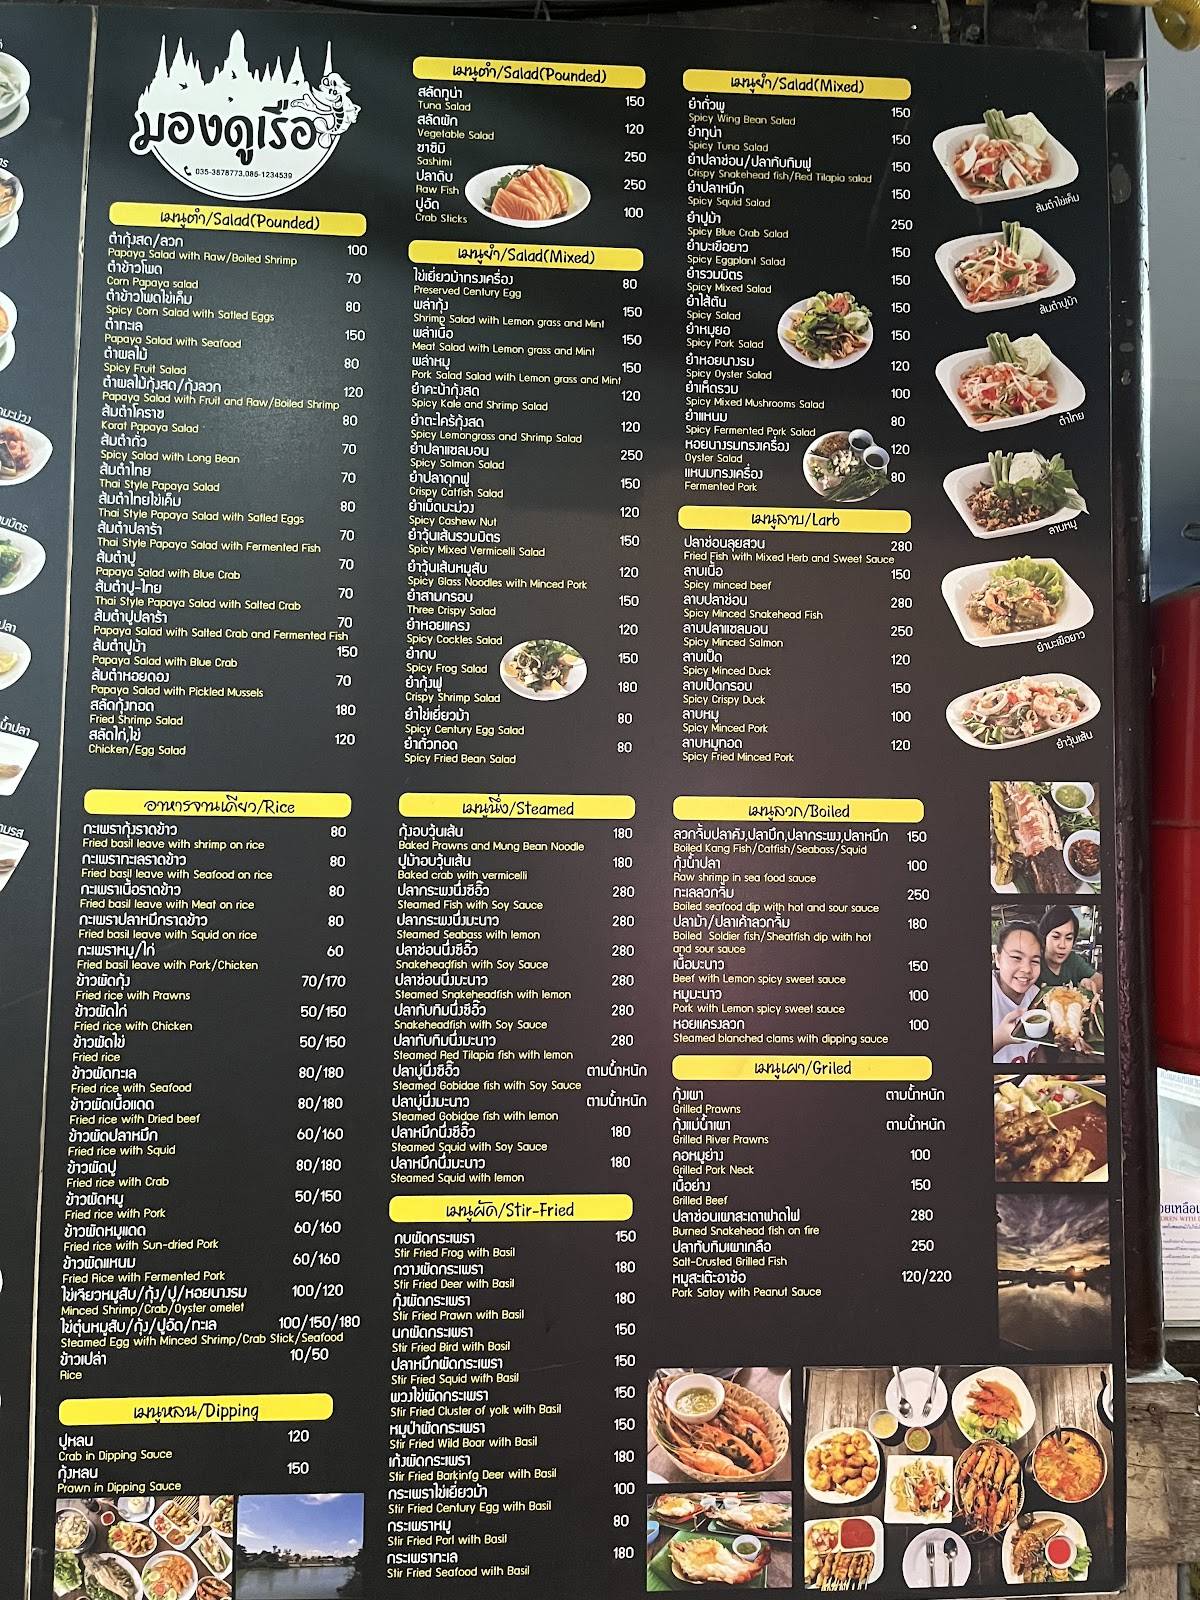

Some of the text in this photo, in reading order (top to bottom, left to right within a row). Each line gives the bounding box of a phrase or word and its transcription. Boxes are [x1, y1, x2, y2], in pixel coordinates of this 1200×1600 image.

[626, 96, 644, 107] 150
[892, 107, 910, 118] 150
[134, 100, 317, 165] มองดูเรือ
[416, 185, 459, 194] Raw Fish
[624, 179, 646, 190] 250
[891, 219, 913, 230] 250
[348, 245, 367, 255] 100
[108, 248, 297, 267] Papaya Salad with Raw/Boiled Shrimp
[623, 279, 637, 289] 80
[414, 285, 521, 299] Preserved Century Egg
[345, 330, 365, 341] 150
[891, 389, 910, 399] 100
[686, 397, 824, 409] Spicy Mixed Mushrooms Salad
[620, 507, 639, 517] 120
[891, 541, 912, 551] 280
[684, 580, 771, 591] Spicy minced beef
[337, 646, 358, 657] 150
[891, 654, 910, 665] 120
[406, 663, 487, 675] Spicy Frog Salad
[91, 685, 263, 697] Papaya Salad with Pickled Mussels
[618, 681, 637, 692] 180
[336, 704, 356, 715] 180
[335, 734, 355, 745] 120
[89, 744, 186, 756] Chicken/Egg Salad
[683, 752, 794, 762] Spicy Fried Minced Pork
[331, 826, 346, 837] 80
[613, 828, 632, 838] 180
[83, 838, 107, 847] Fried
[111, 839, 133, 848] basil
[137, 839, 164, 848] leave
[168, 839, 190, 848] with
[194, 840, 226, 851] shrimp
[399, 841, 584, 852] Baked Prawns and Mung Bean Noodle
[908, 889, 929, 900] 250
[302, 974, 346, 990] 70/170
[673, 974, 695, 982] Beef
[699, 974, 719, 982] with
[723, 974, 755, 983] Lemon
[758, 976, 782, 985] spicy
[786, 975, 814, 983] sweet
[299, 1065, 344, 1081] 80/180
[673, 1104, 741, 1113] Grilled Prawns
[911, 1209, 933, 1221] 280
[616, 1230, 636, 1242] 150
[64, 1239, 219, 1251] Fried rice with Sun-dried Pork
[395, 1247, 515, 1259] Stir Fried Frog with Basil
[902, 1269, 952, 1284] 120/220
[292, 1282, 343, 1299] 100/120
[279, 1314, 360, 1331] 100/150/180
[290, 1346, 328, 1363] 10/50
[288, 1430, 309, 1442] 120
[59, 1451, 82, 1461] Crab
[99, 1450, 136, 1462] Dipping
[141, 1450, 172, 1459] Sauce
[614, 1515, 629, 1527] 80
